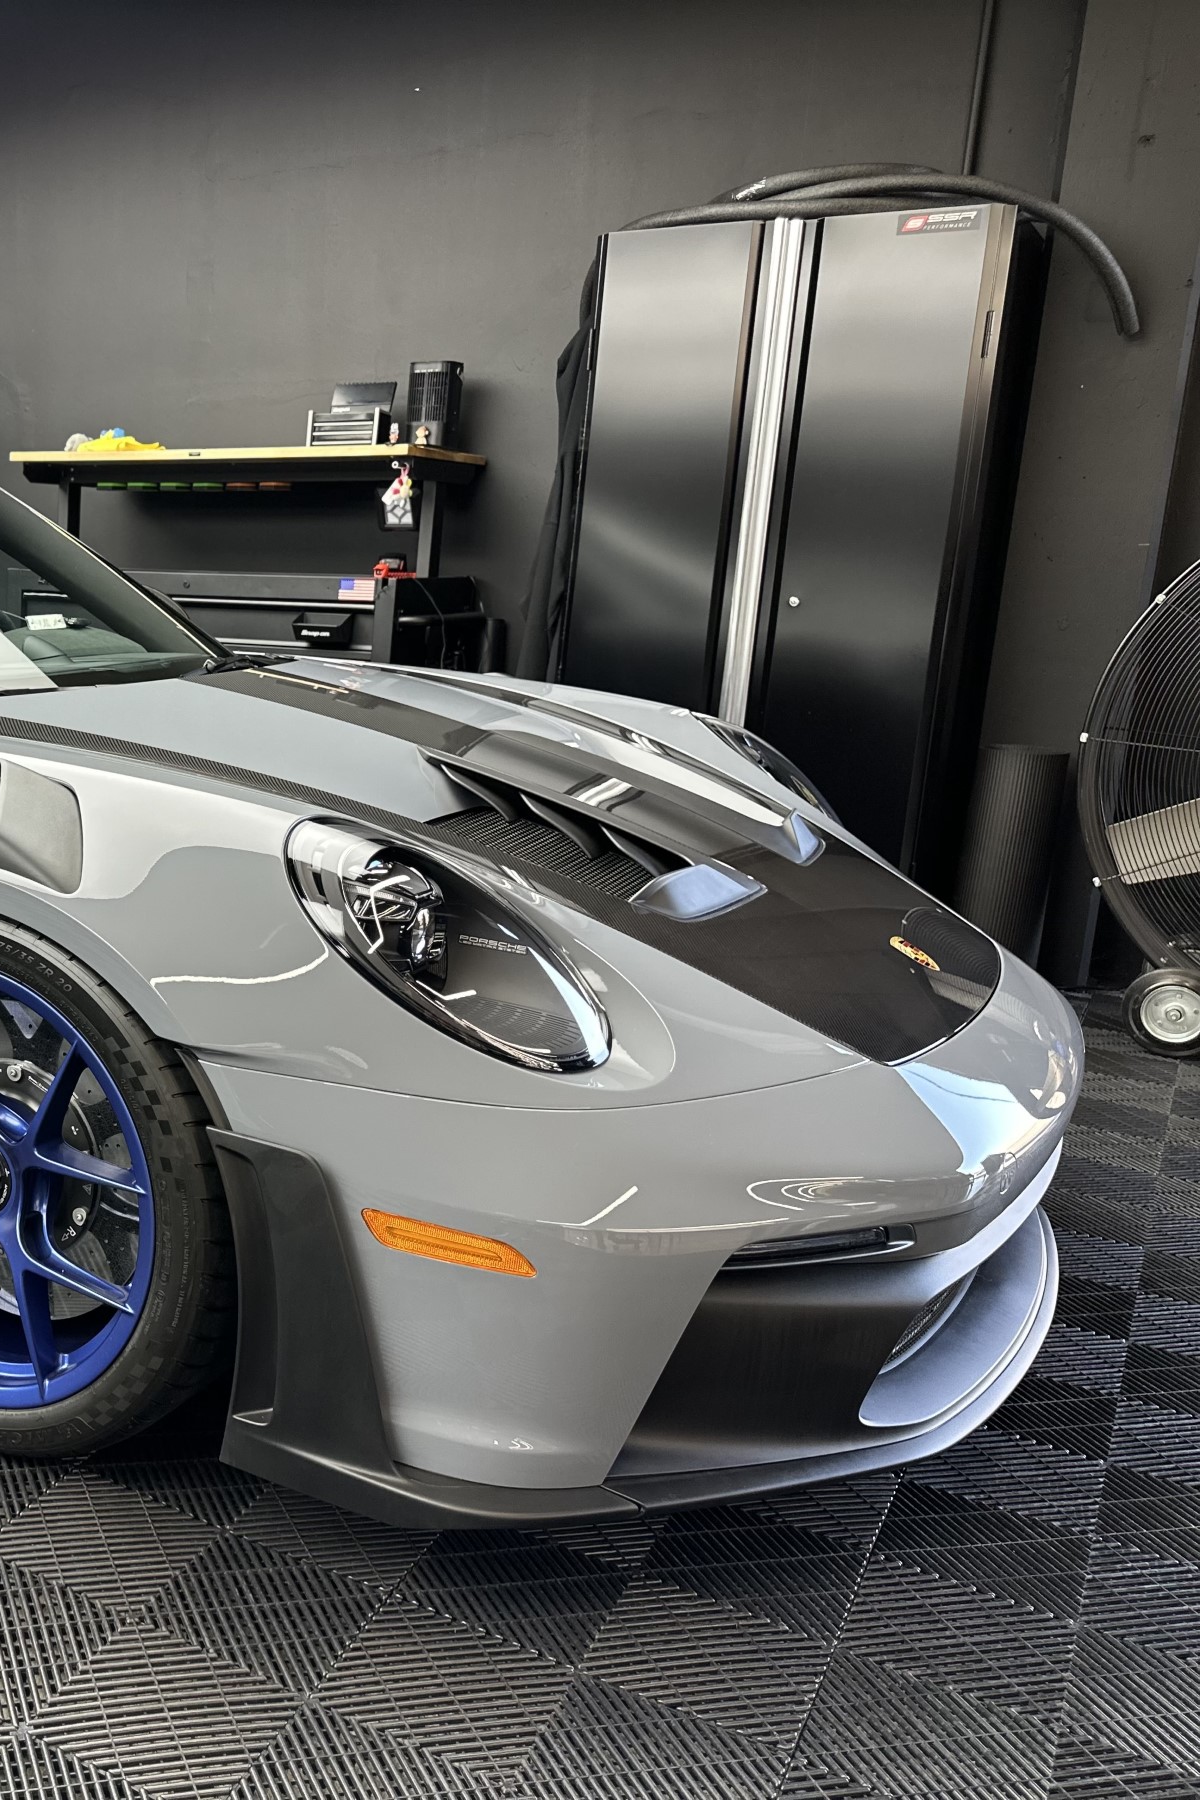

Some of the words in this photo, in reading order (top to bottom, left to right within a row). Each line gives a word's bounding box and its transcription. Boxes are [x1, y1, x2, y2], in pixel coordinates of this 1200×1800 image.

[923, 222, 971, 230] PERFORMANCE
[459, 934, 527, 951] PORSCHE
[38, 963, 55, 978] ZR
[57, 977, 73, 992] 20
